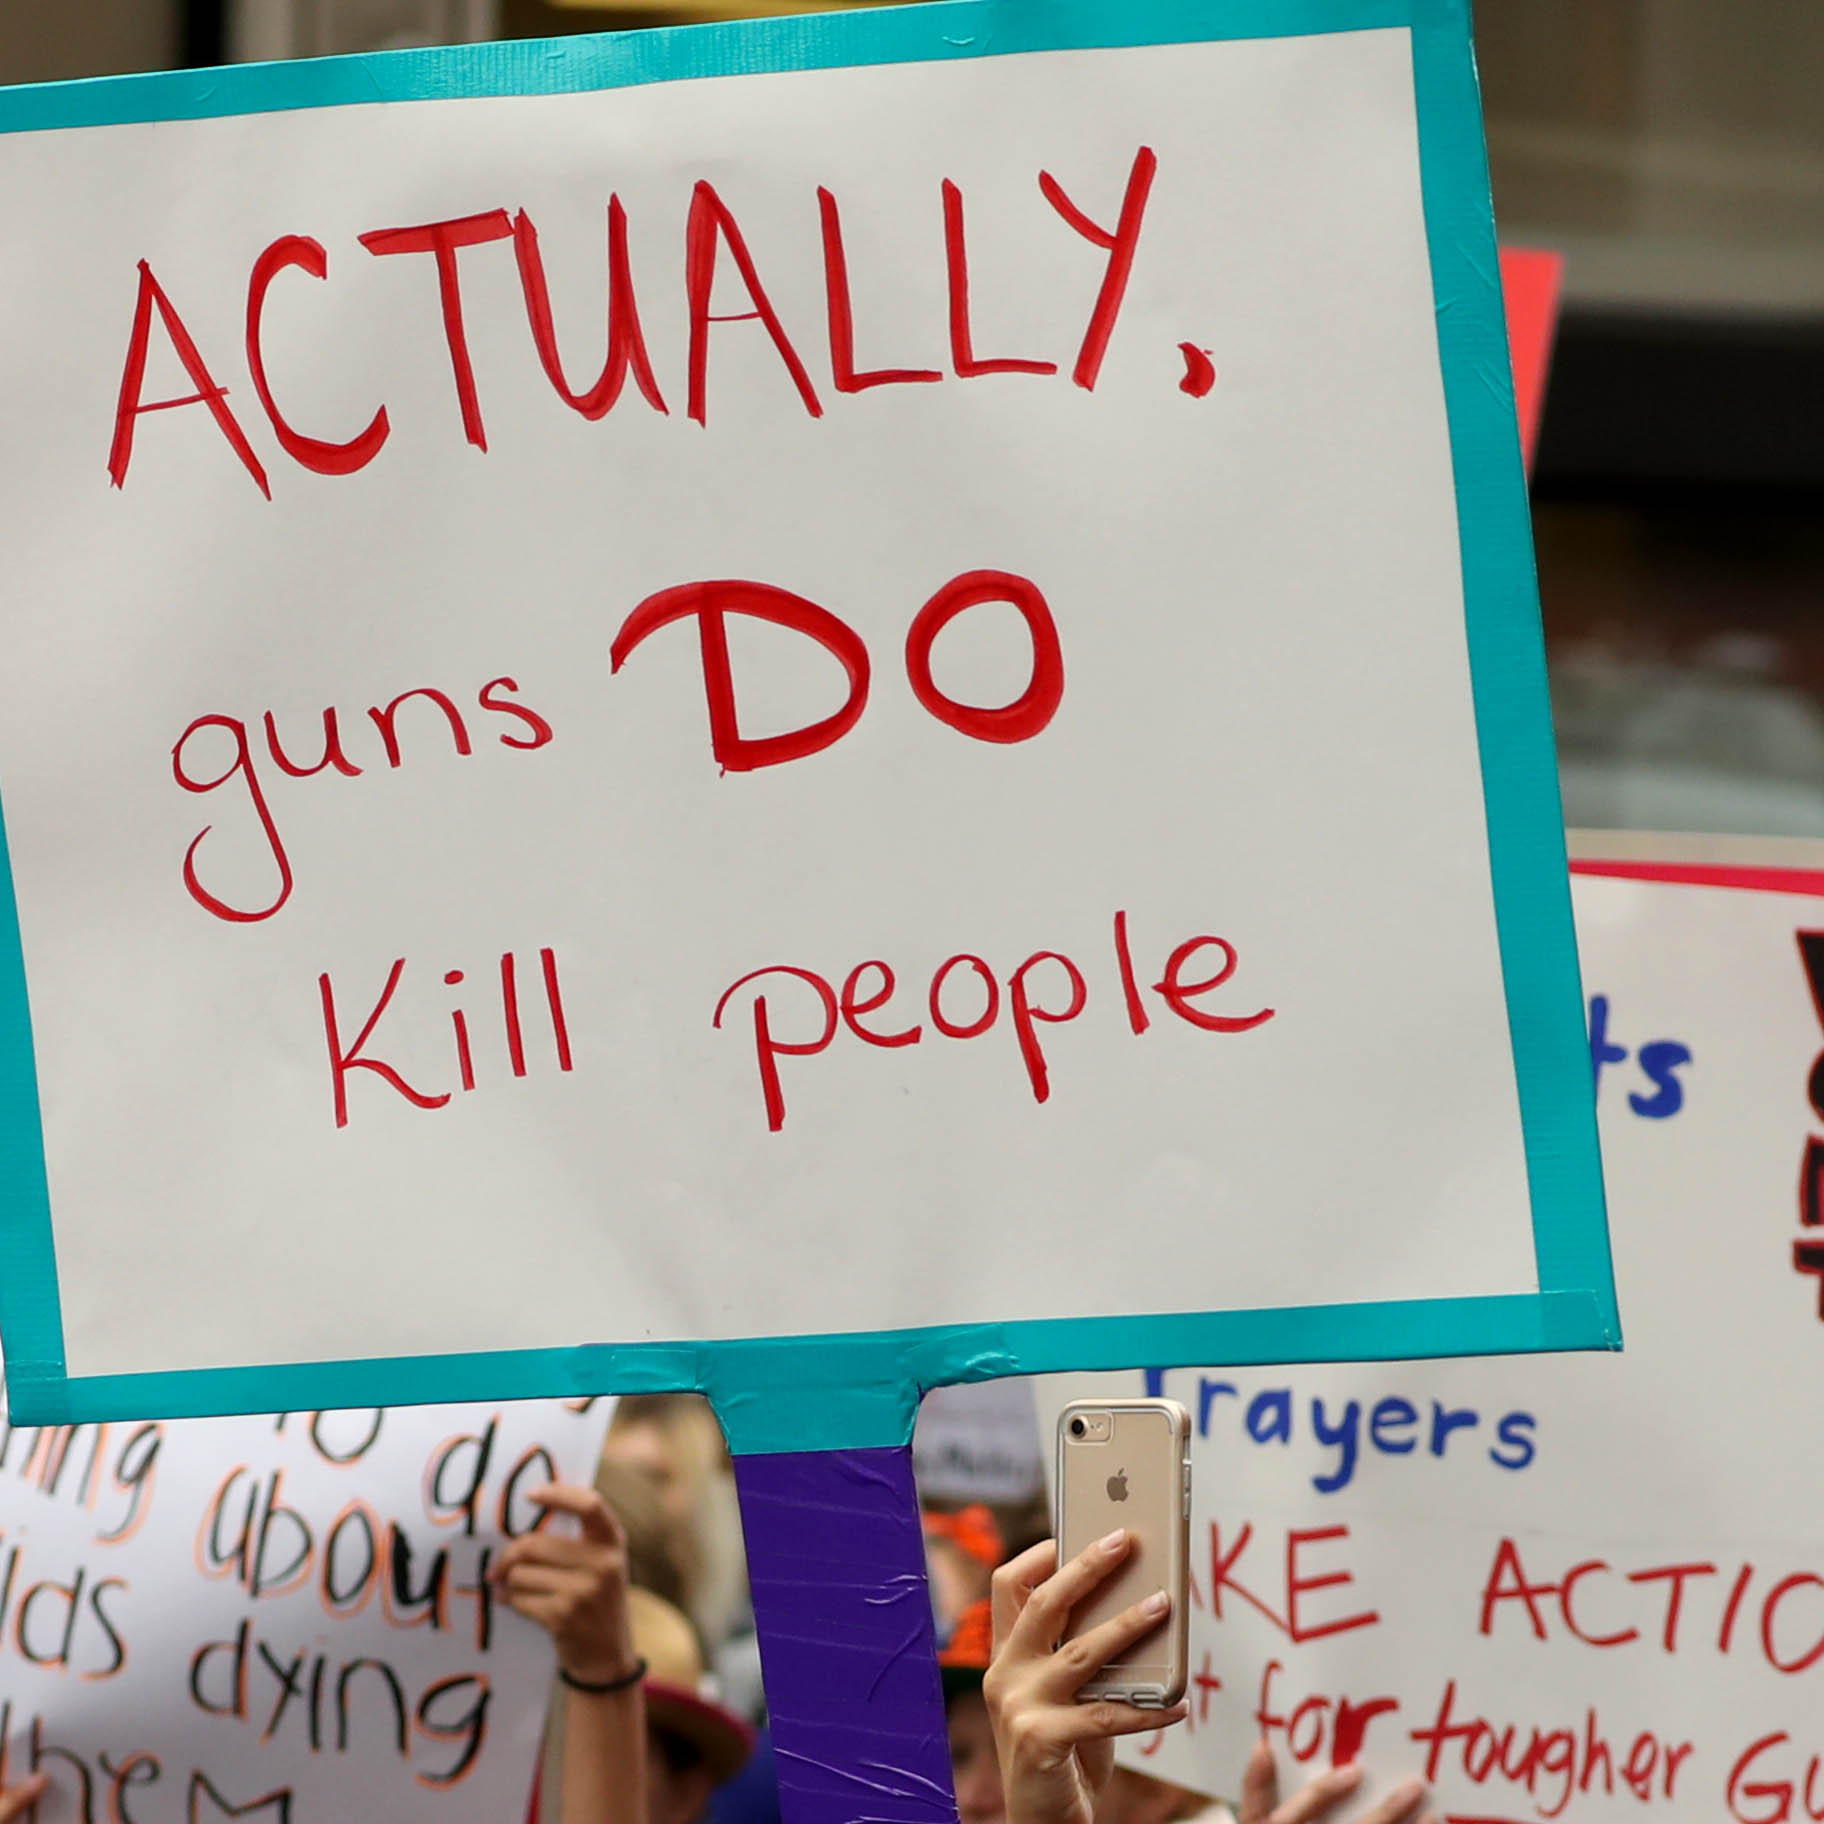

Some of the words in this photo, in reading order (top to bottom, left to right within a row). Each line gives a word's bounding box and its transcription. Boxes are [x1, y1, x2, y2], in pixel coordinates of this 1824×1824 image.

[173, 675, 555, 925] guns
[611, 570, 1064, 776] DO
[714, 911, 1275, 1132] people
[1190, 1520, 1380, 1644] KE
[188, 1616, 493, 1791] dying
[1408, 1680, 1694, 1819] tougher
